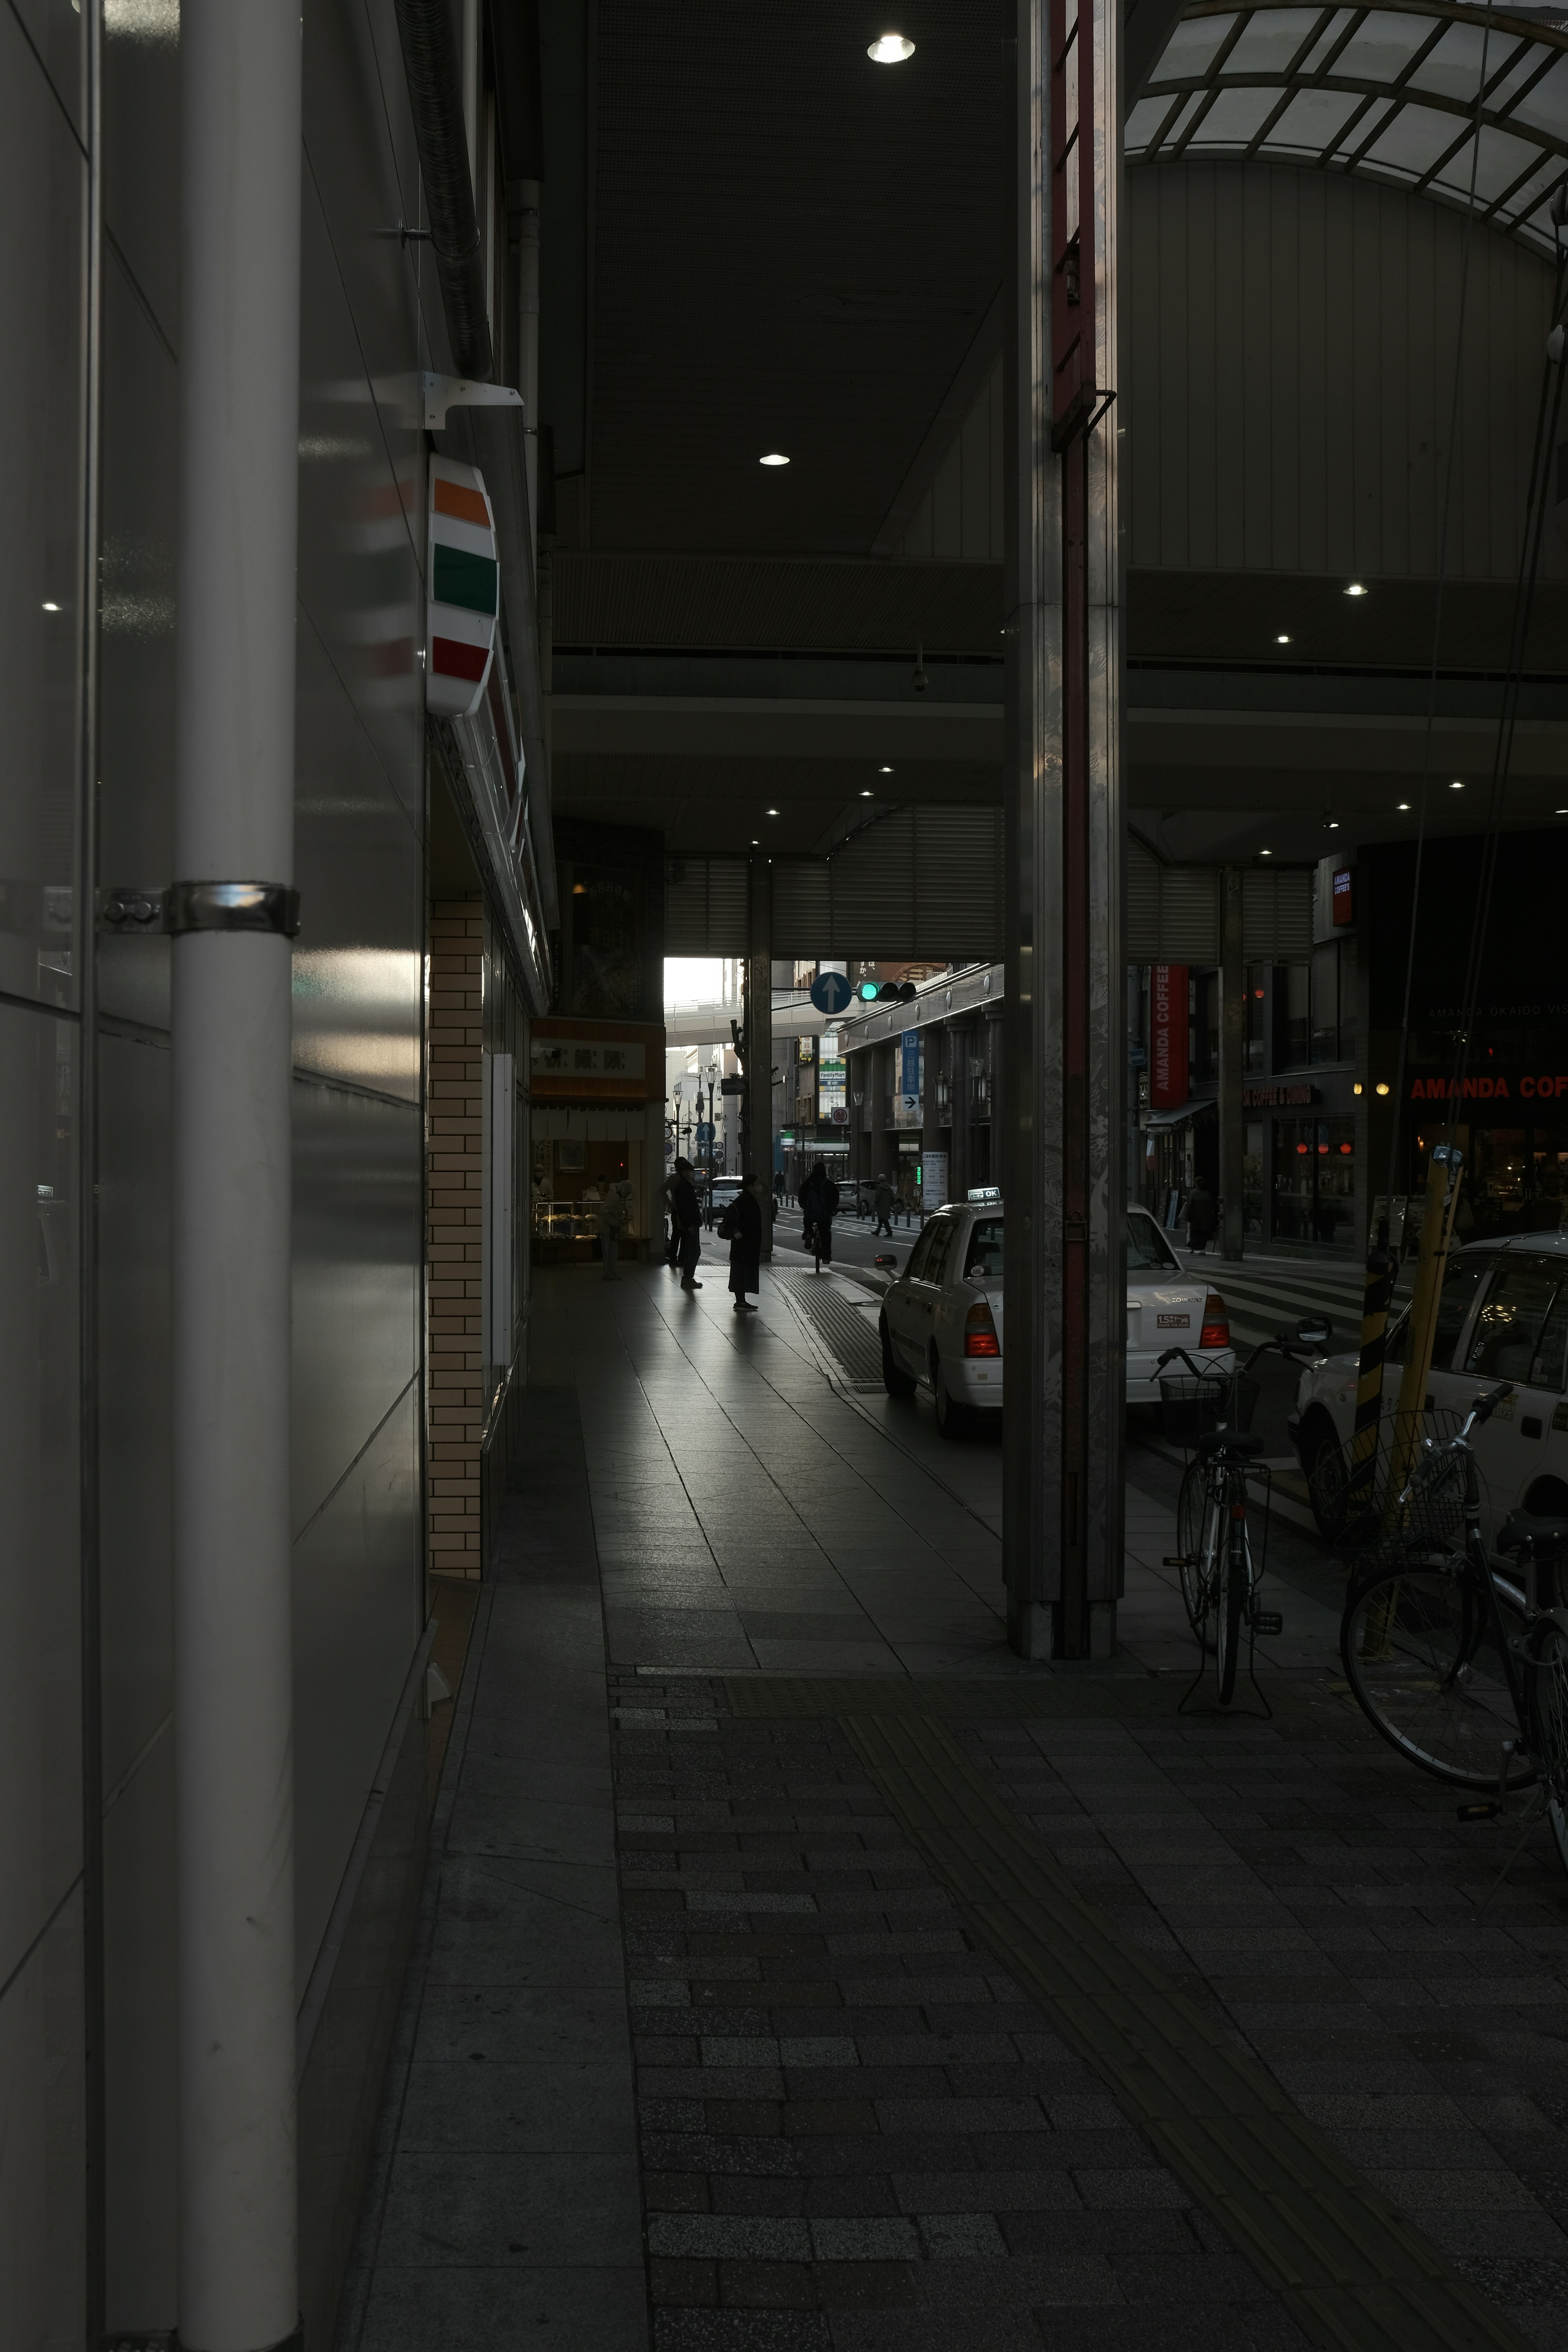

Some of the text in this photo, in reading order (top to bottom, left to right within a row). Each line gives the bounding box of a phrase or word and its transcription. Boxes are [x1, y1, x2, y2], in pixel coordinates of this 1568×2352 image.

[1490, 1005, 1540, 1016] OKAIDO
[907, 1051, 915, 1091] 三越駐車場
[1156, 1028, 1169, 1091] AMANDA
[1253, 1087, 1278, 1107] COFFEE
[1286, 1084, 1311, 1105] DINING
[1411, 1076, 1510, 1099] AMANDA
